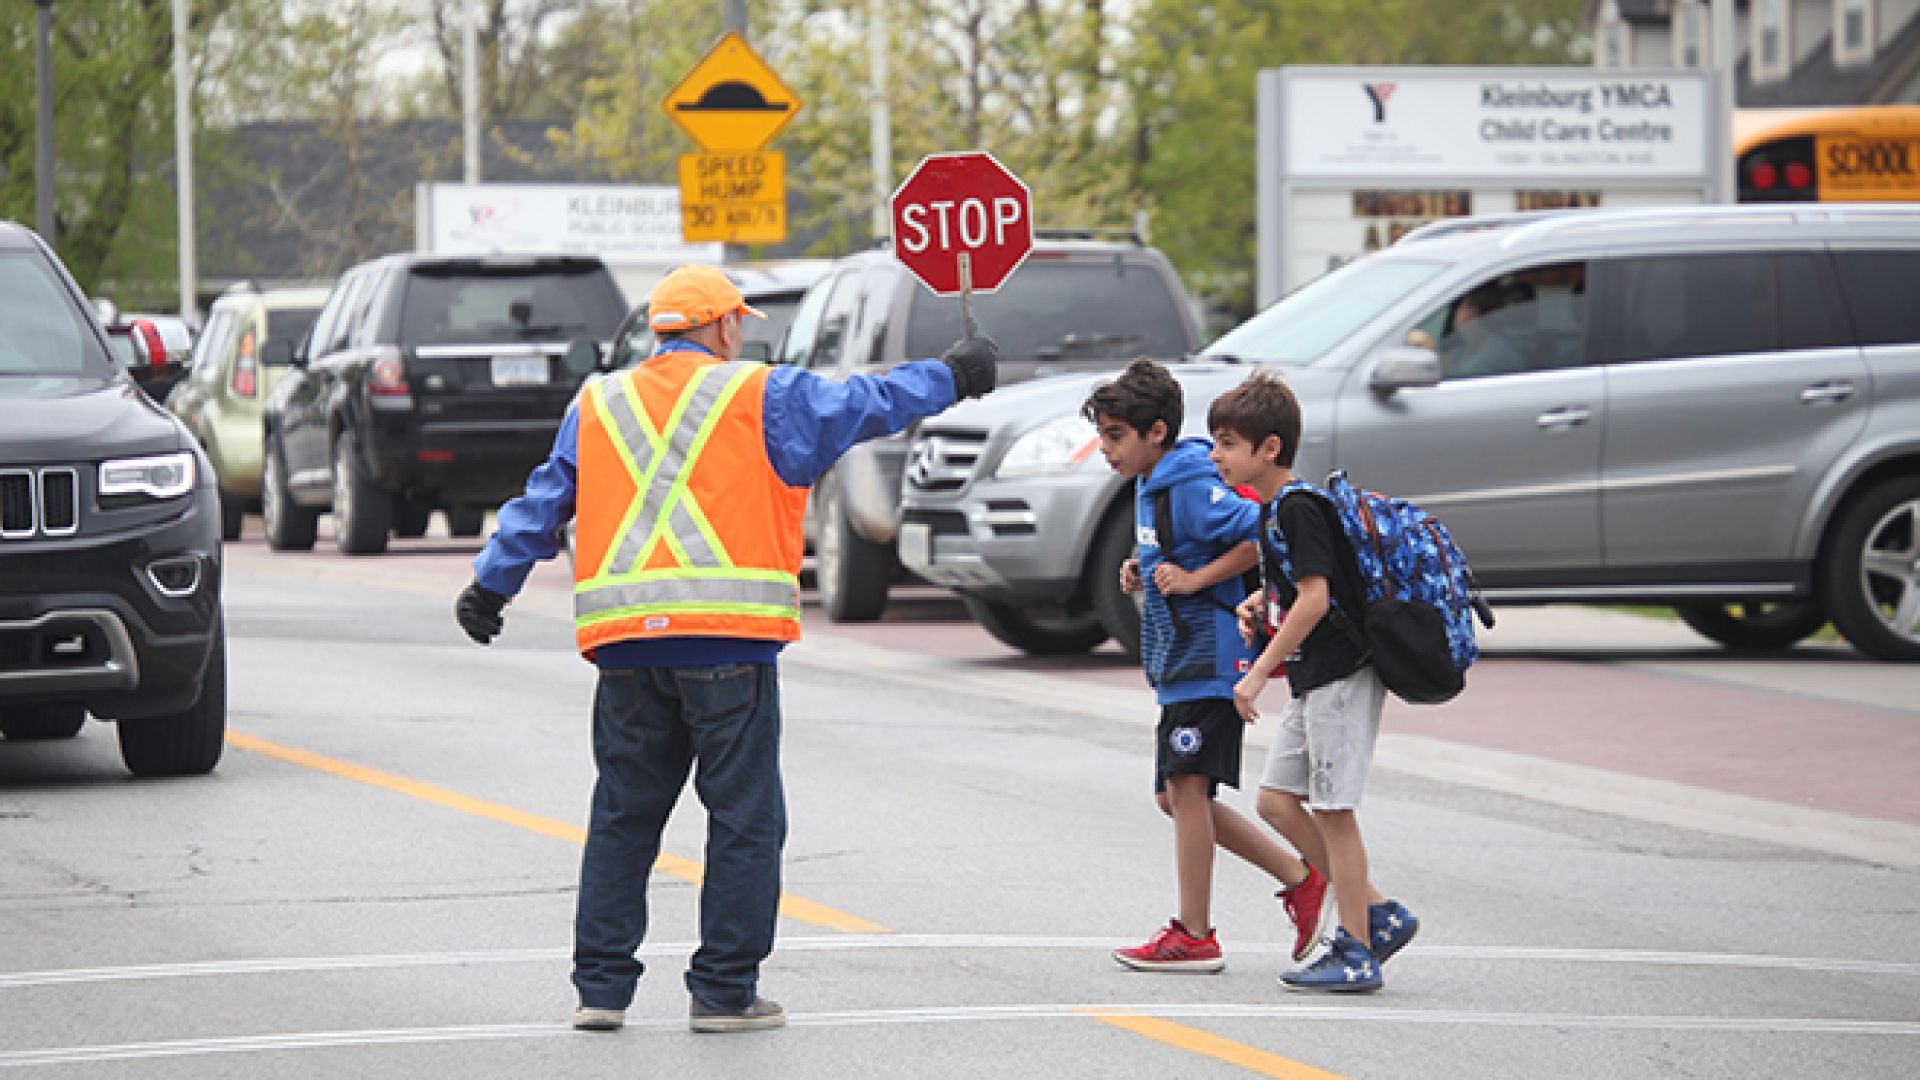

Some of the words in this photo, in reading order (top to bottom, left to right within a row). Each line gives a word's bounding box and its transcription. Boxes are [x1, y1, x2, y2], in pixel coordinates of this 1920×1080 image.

[1480, 82, 1593, 114] Kleinburg
[1600, 82, 1673, 108] YMCA
[1480, 118, 1536, 142] Child
[1541, 118, 1591, 142] Care
[1600, 118, 1673, 142] Centre
[697, 155, 767, 177] SPEED
[1827, 142, 1916, 175] SCHOOL
[700, 178, 764, 201] HUMP
[567, 195, 681, 217] KLEINBUR
[687, 204, 715, 227] 30
[725, 204, 778, 225] km/h
[902, 197, 1021, 252] STOP
